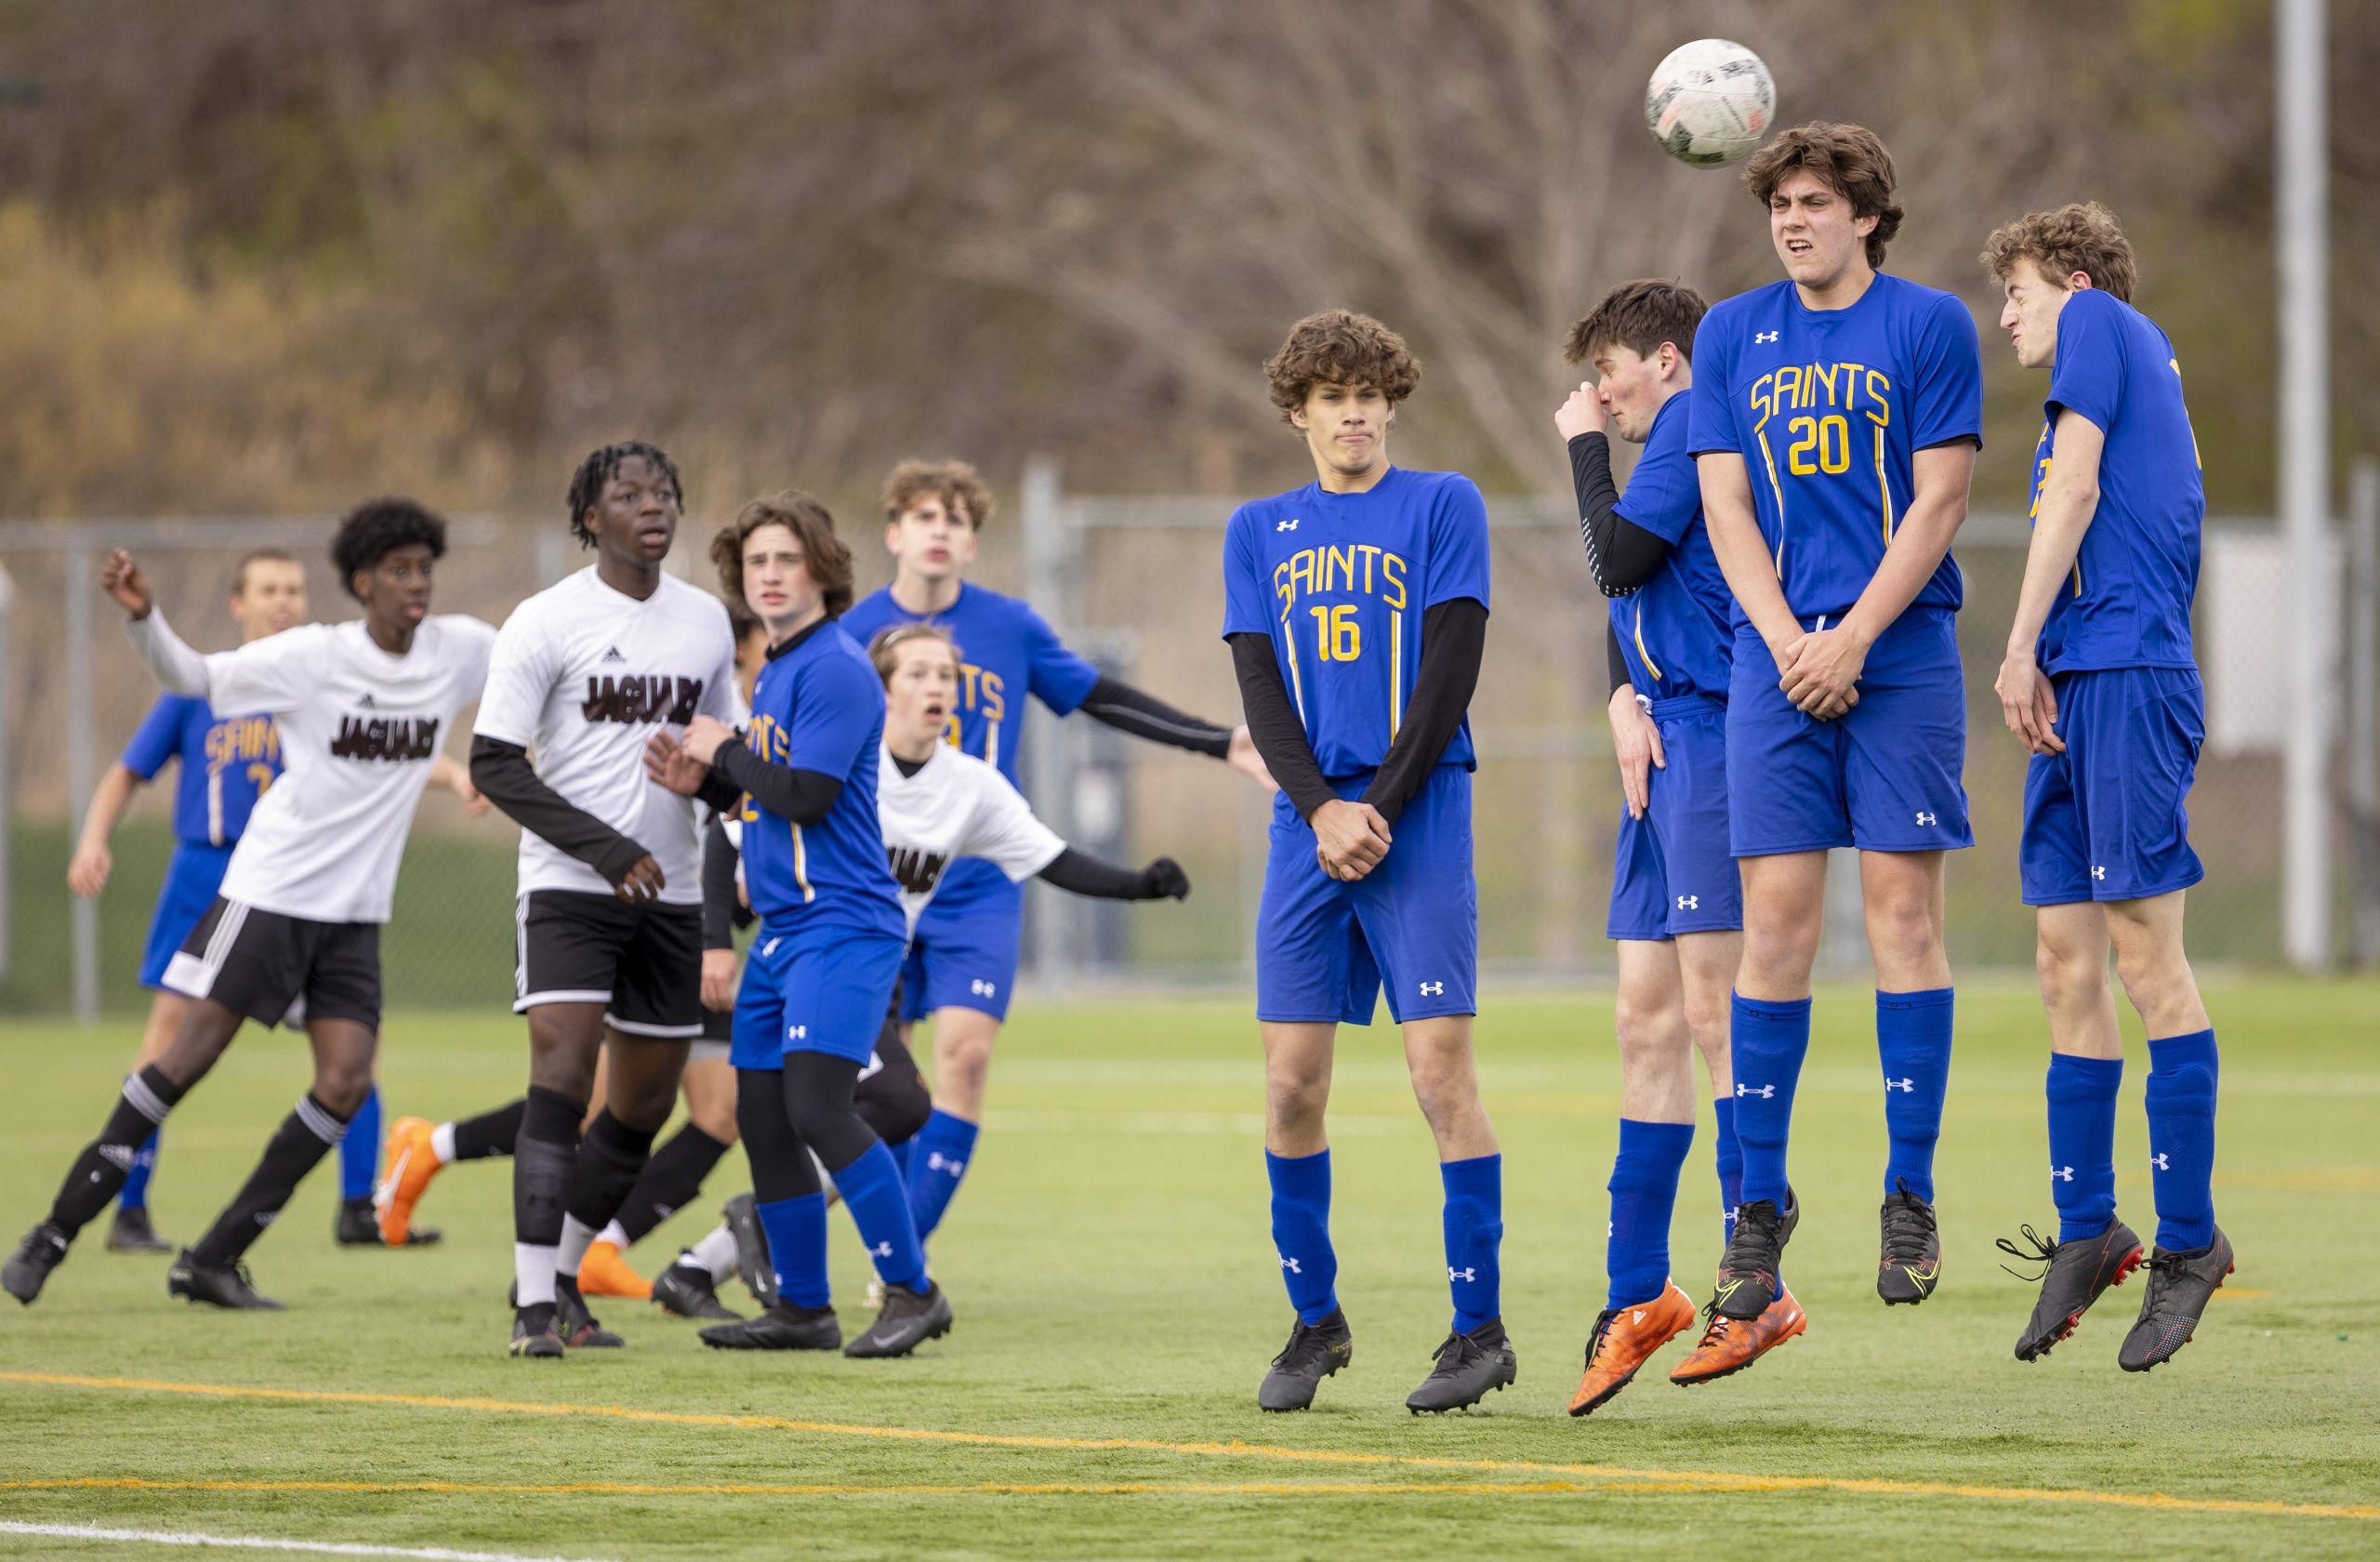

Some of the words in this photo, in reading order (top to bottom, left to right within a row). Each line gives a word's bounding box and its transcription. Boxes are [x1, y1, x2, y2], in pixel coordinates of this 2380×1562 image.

[1751, 362, 1890, 434] SAINTS
[1788, 415, 1850, 476] 20
[1274, 544, 1407, 623] SAINTS
[1309, 604, 1361, 662] 16
